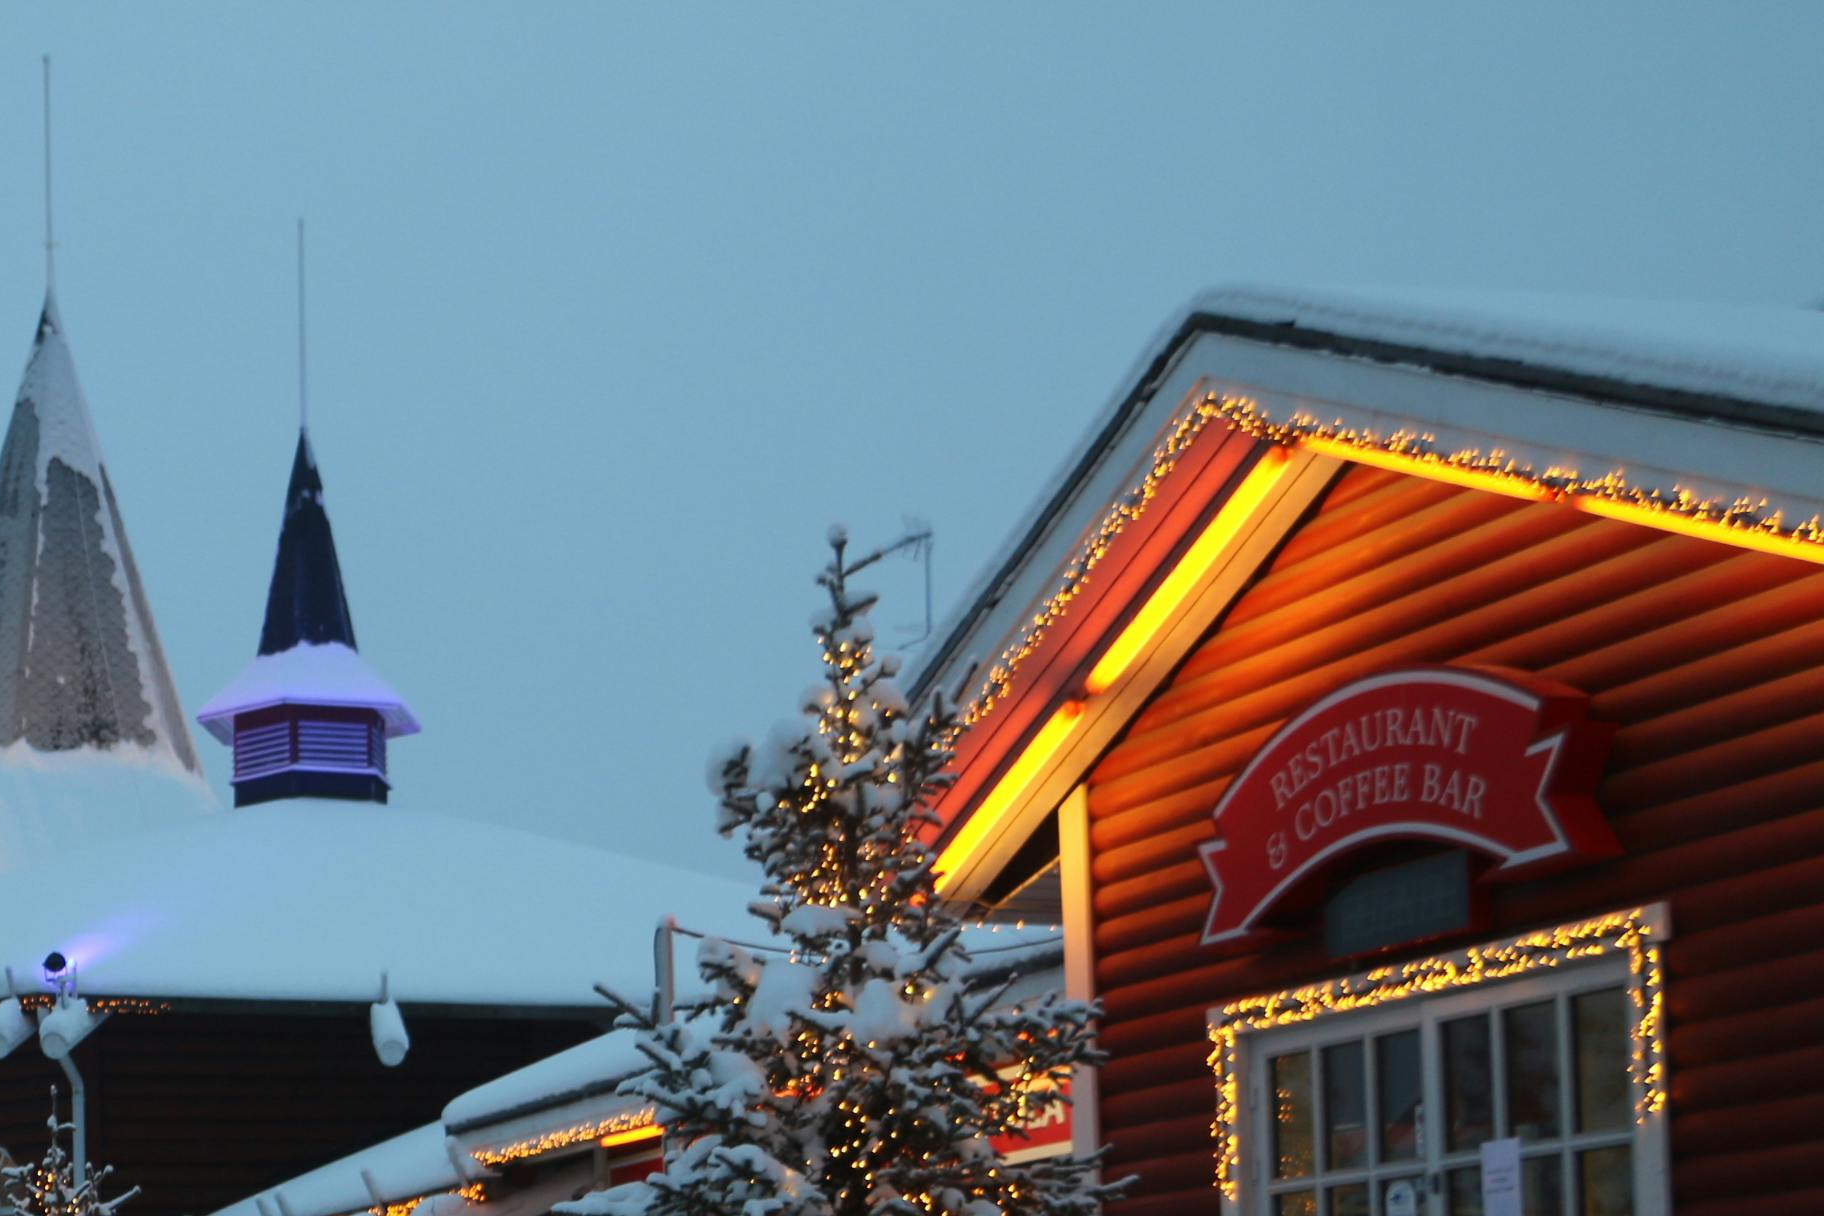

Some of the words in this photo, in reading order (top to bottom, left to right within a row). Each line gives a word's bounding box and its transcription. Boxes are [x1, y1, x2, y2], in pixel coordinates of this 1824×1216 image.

[1268, 706, 1475, 810] RESTAURANT
[1265, 832, 1289, 870] &
[1294, 761, 1411, 841] COFFEE
[1421, 762, 1486, 819] BAR
